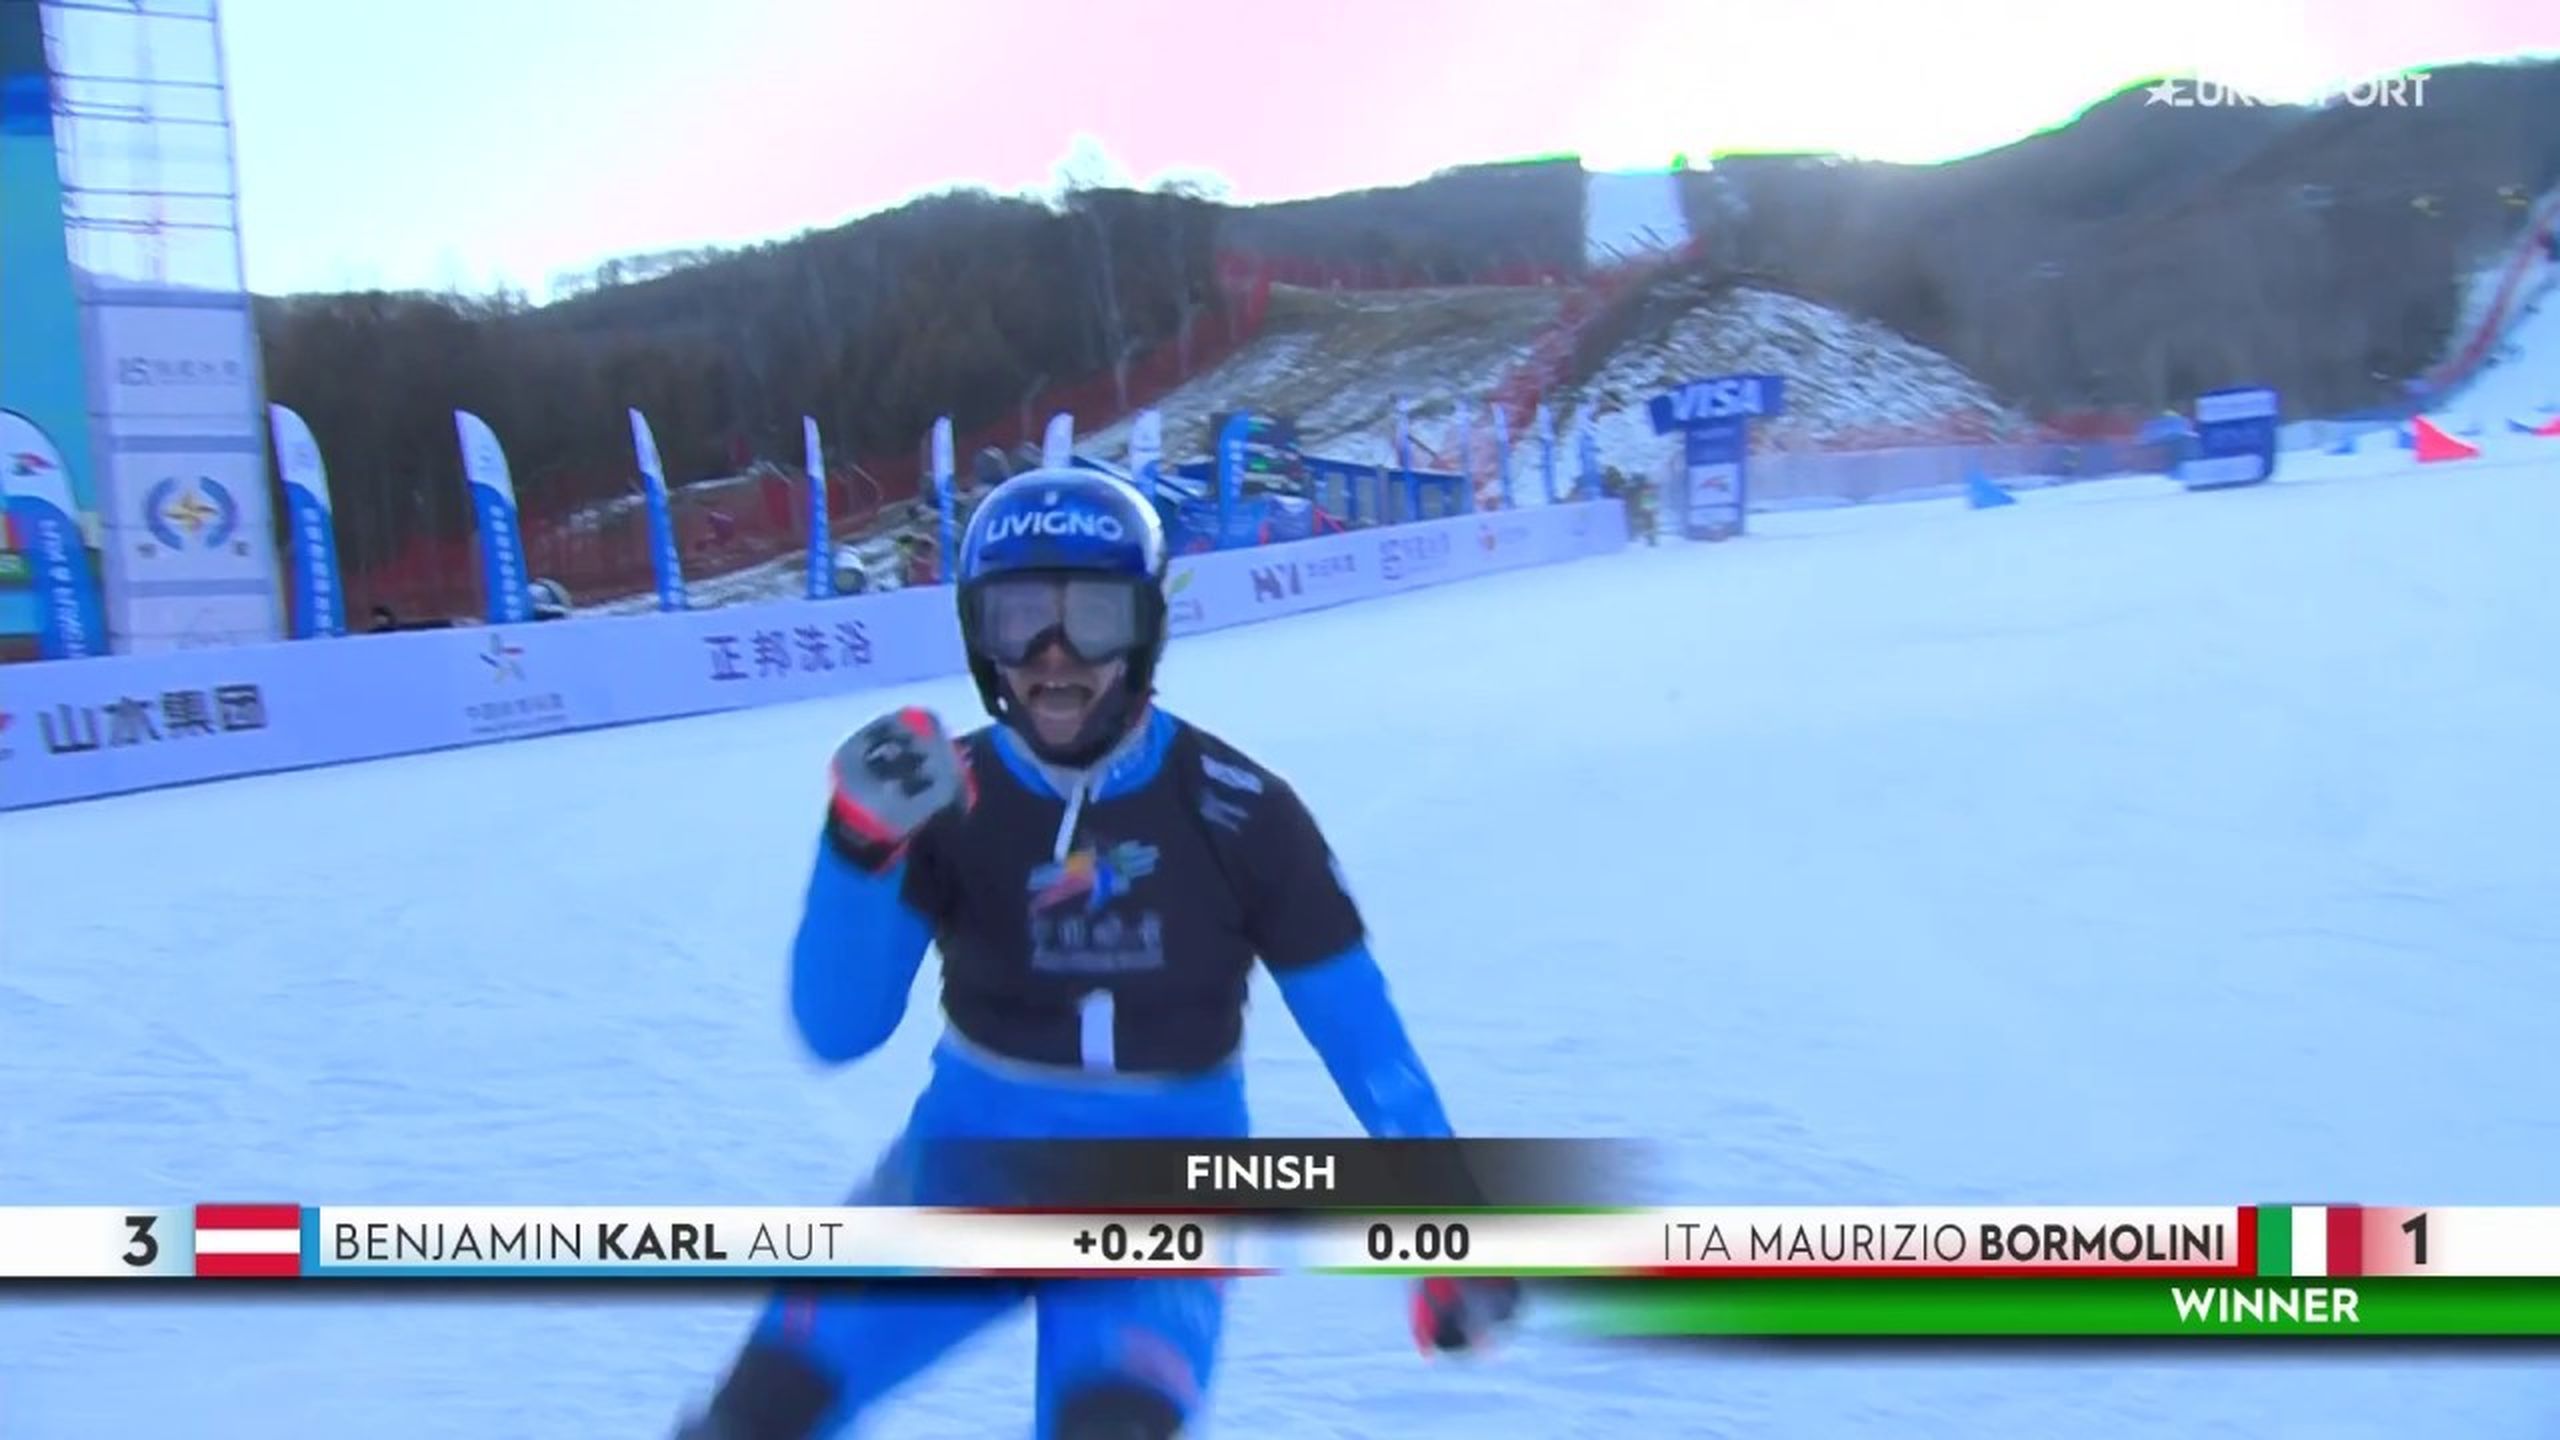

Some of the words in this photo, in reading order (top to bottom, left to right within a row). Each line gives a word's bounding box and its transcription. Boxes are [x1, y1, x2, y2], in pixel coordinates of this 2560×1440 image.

[1671, 378, 1764, 420] VISA
[985, 510, 1124, 542] LIVIGNO
[37, 684, 268, 755] 山水集团
[1080, 989, 1117, 1074] 1
